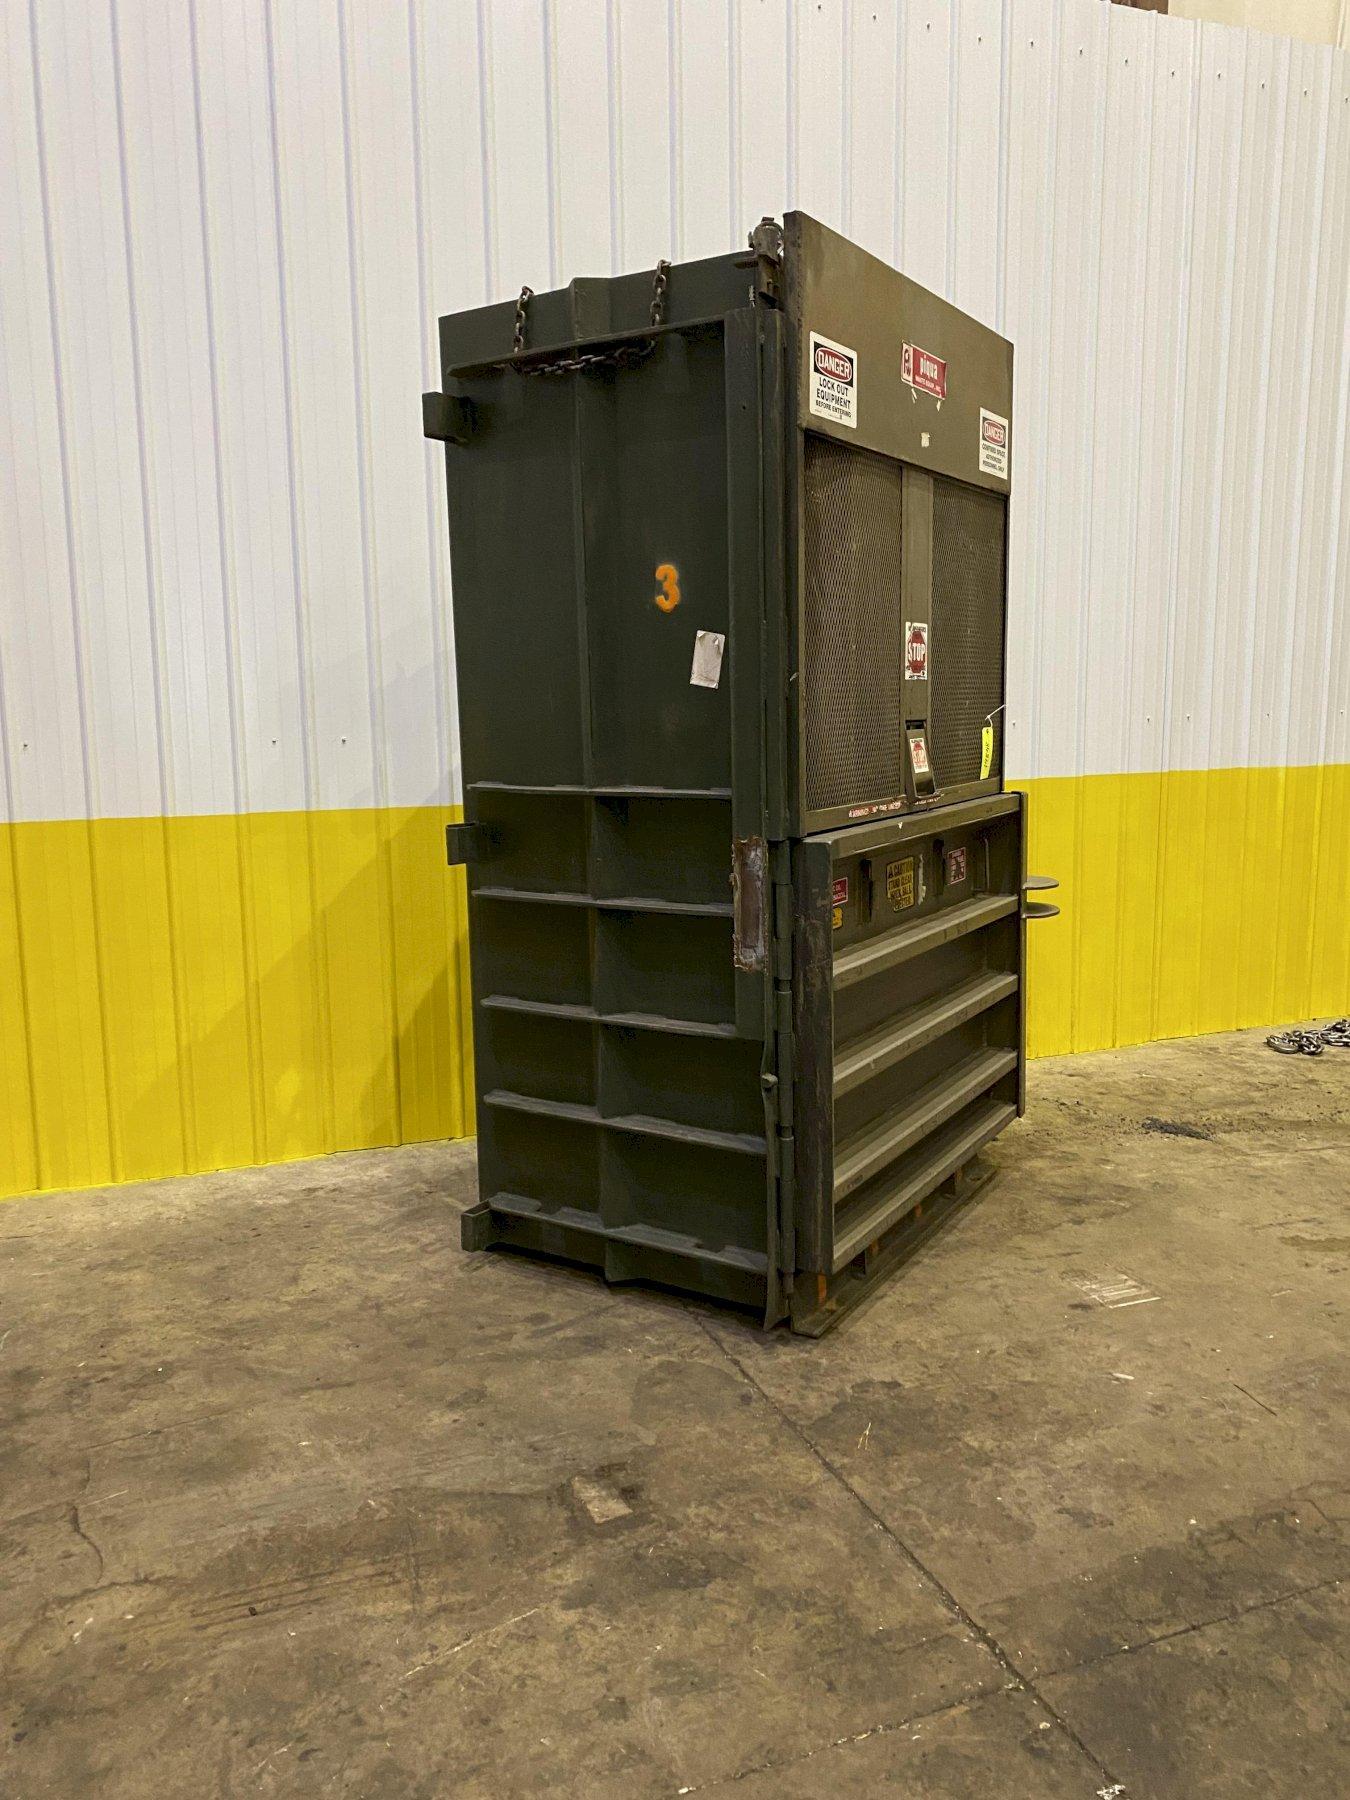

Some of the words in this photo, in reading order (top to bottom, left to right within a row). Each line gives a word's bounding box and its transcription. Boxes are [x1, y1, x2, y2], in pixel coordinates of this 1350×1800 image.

[818, 351, 850, 378] DANGER
[819, 377, 835, 391] LOCK
[836, 383, 848, 396] OUT
[816, 387, 851, 409] EQUIPMENT
[816, 400, 831, 411] BEFORE
[832, 404, 851, 417] ENTERING
[984, 422, 1004, 440] DANGER
[655, 563, 681, 613] 3
[908, 642, 926, 662] STOP
